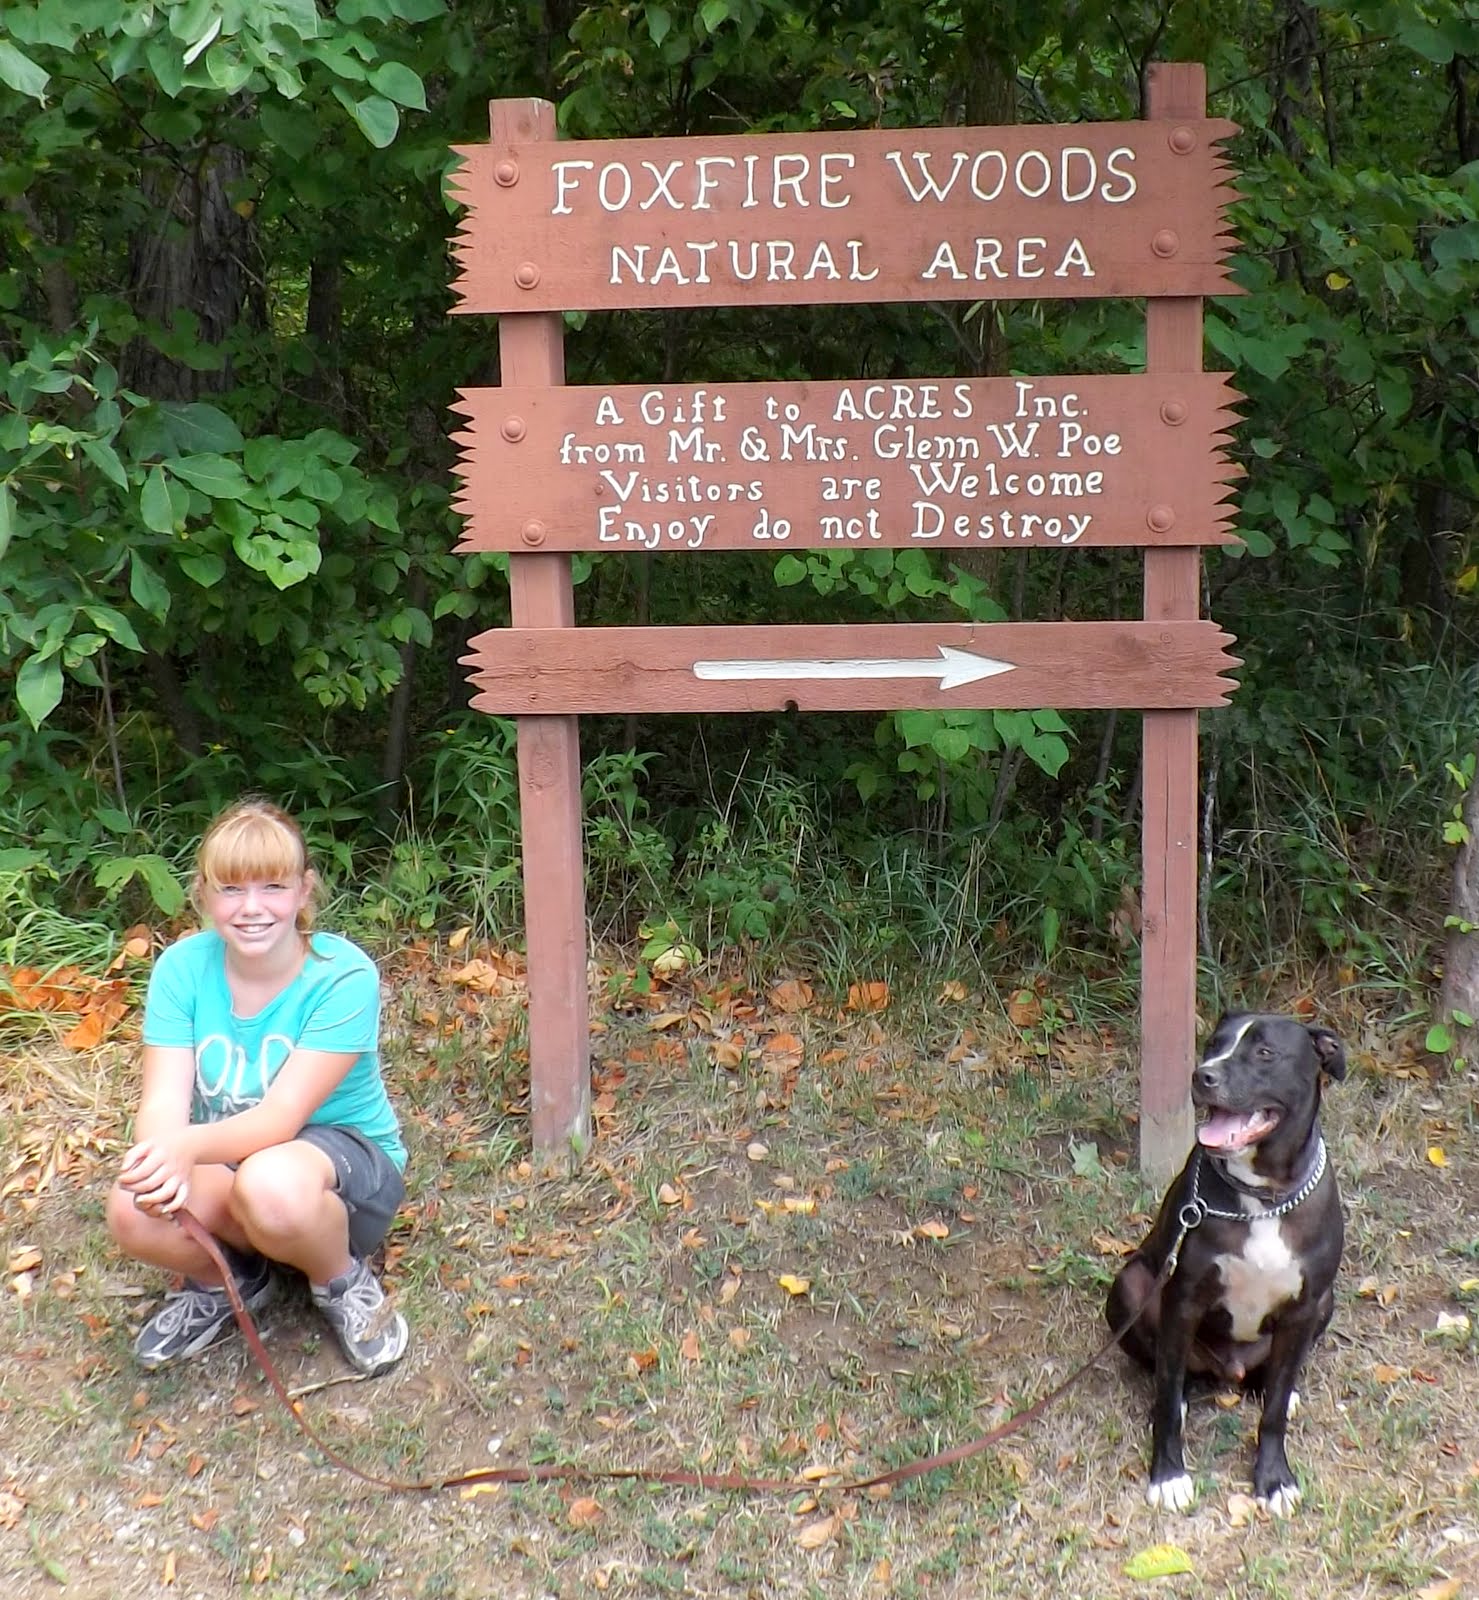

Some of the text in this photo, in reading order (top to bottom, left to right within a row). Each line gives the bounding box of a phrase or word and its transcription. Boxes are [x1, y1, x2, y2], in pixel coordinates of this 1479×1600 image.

[551, 147, 1137, 215] FOXFIRE WOODS
[609, 237, 1095, 285] NATURAL AREA
[595, 381, 1089, 426] A Gift to ACRES Inc.
[559, 422, 1122, 465] from Mr. & Mrs. Glenn W. Poe
[599, 461, 1103, 503] Visitors are Welcome
[599, 500, 1092, 549] Enjoy do not Destroy
